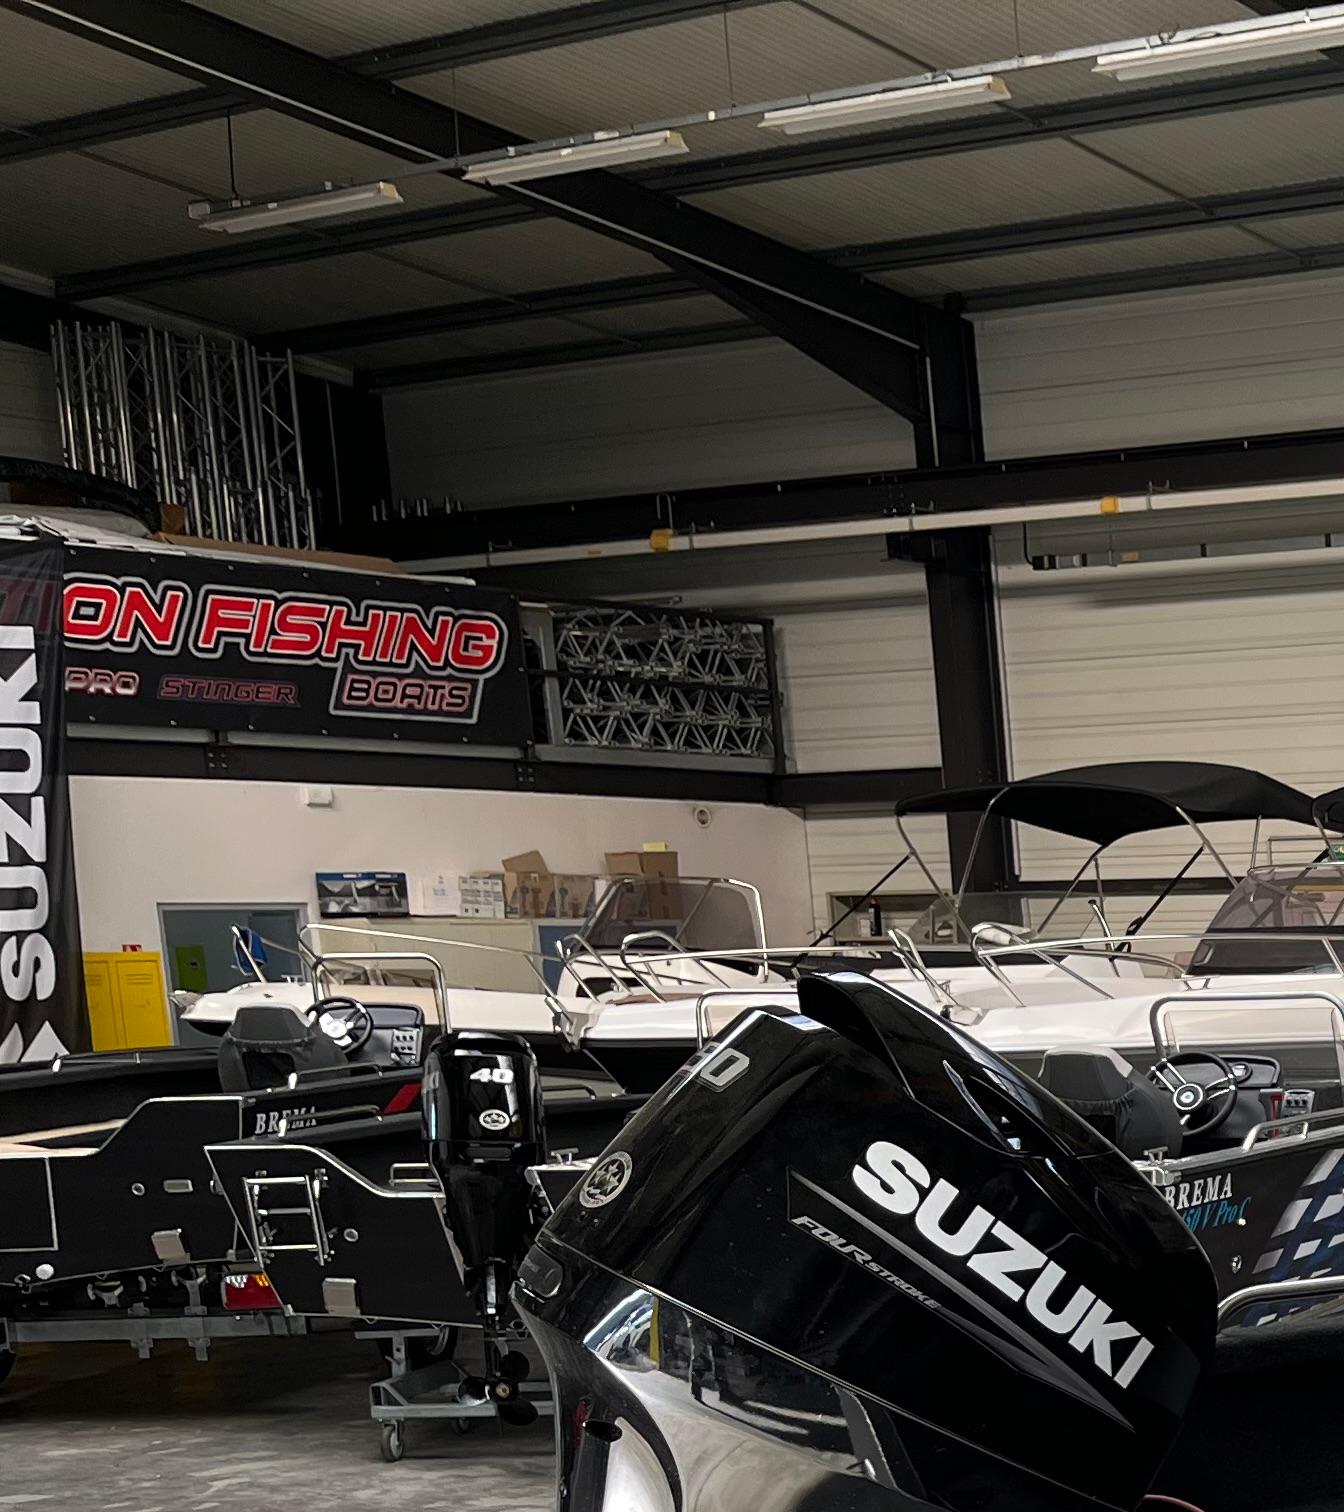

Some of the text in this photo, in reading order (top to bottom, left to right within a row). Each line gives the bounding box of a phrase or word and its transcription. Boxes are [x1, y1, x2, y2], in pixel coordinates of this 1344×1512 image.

[197, 593, 501, 672] FISHING
[159, 676, 298, 704] STINGER
[342, 672, 473, 713] BOATS
[0, 625, 56, 1001] SUZUKI
[470, 1067, 514, 1083] 40
[1165, 1172, 1233, 1210] BREMA
[853, 1141, 1155, 1391] SUZUKI
